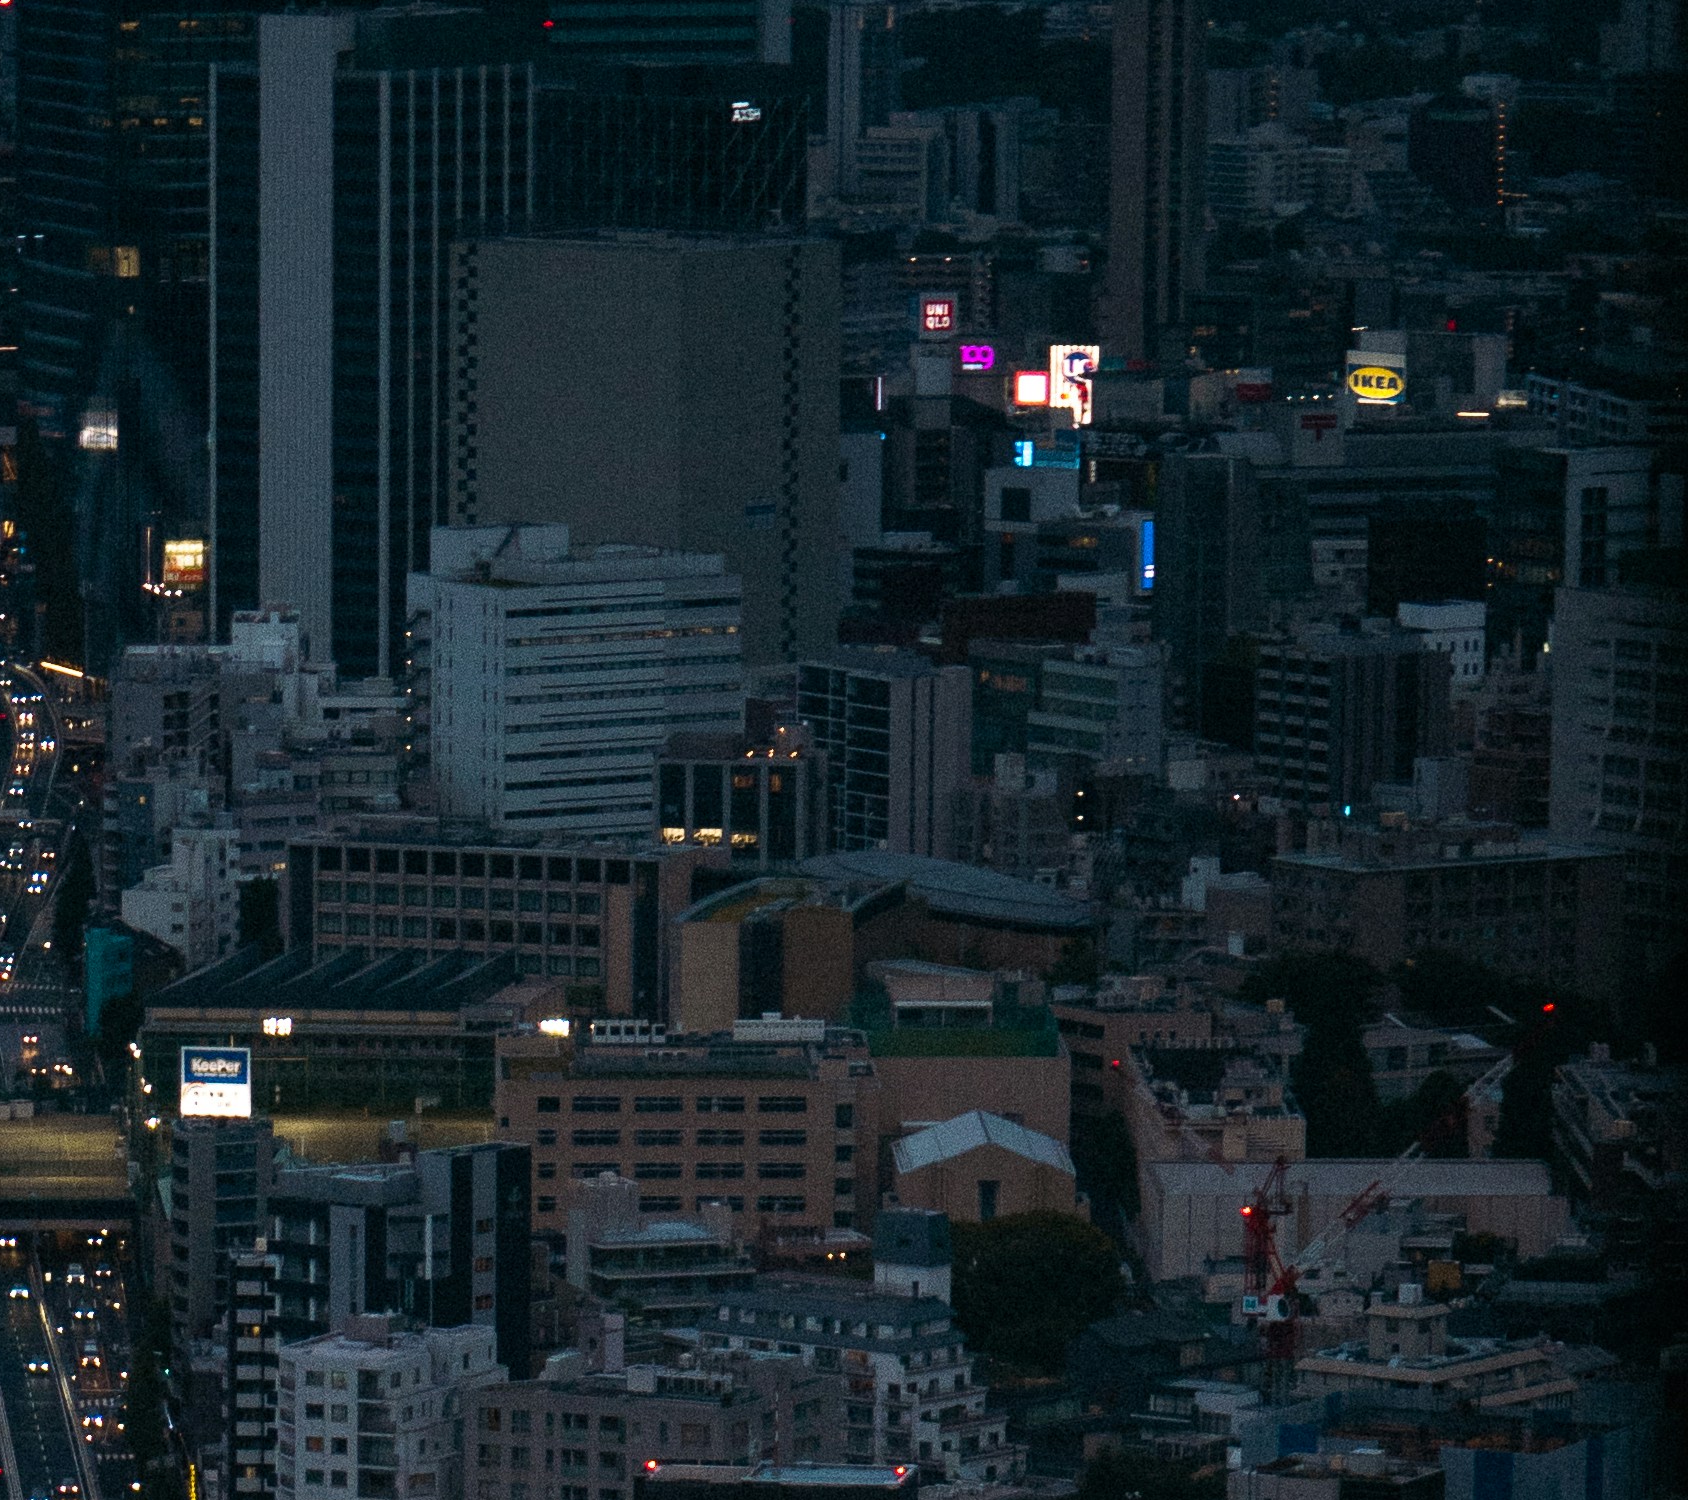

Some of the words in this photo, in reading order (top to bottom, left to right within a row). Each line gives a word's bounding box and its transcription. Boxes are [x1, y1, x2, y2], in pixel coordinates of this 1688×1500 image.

[925, 303, 949, 315] UNI
[1353, 374, 1398, 389] IKEA
[191, 1057, 242, 1073] KeePer
